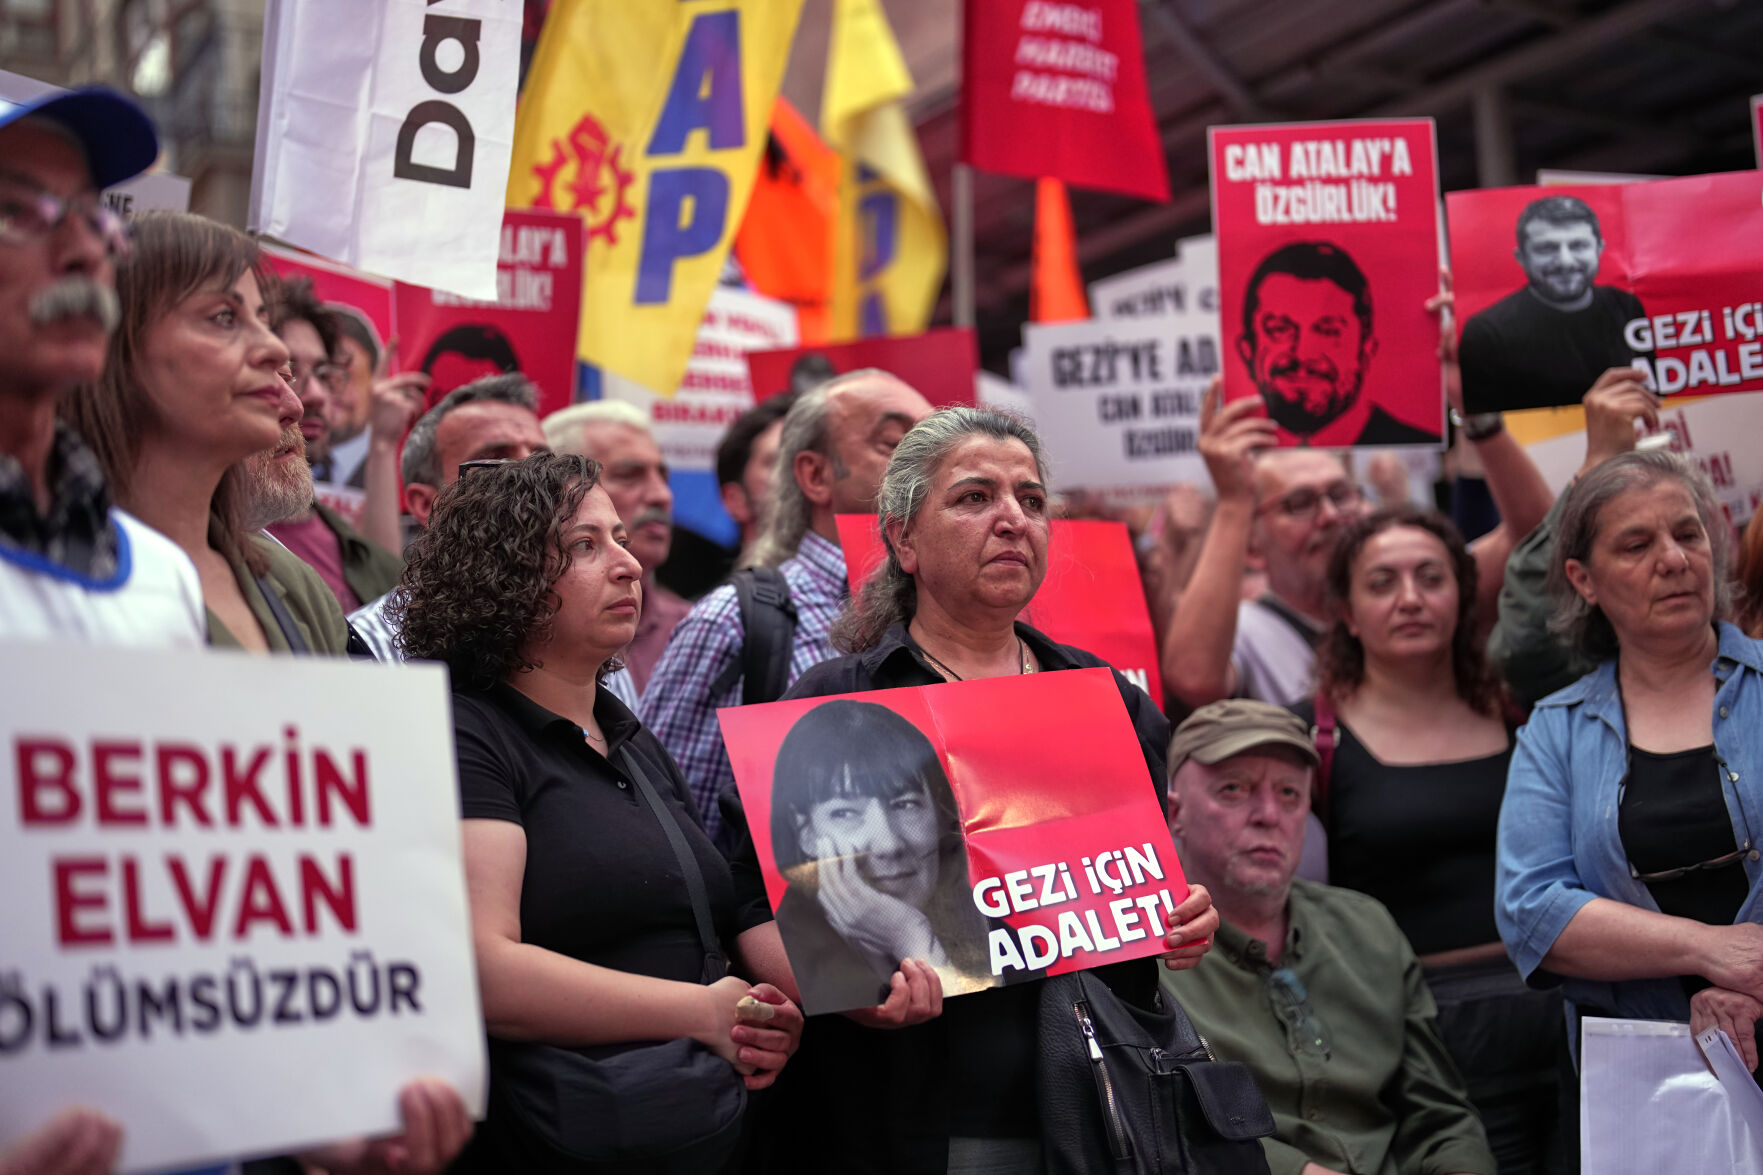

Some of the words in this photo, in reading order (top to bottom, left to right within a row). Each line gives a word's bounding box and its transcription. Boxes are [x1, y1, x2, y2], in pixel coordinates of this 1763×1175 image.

[394, 0, 481, 189] Da
[1225, 143, 1281, 181] CAN
[1289, 138, 1412, 178] ATALAY'A
[1256, 178, 1398, 224] ÖZGÜRLÜK!
[1723, 302, 1763, 341] İÇİ
[1631, 342, 1763, 394] ADALE
[14, 724, 372, 830] BERKİN
[51, 850, 358, 950] ELVAN
